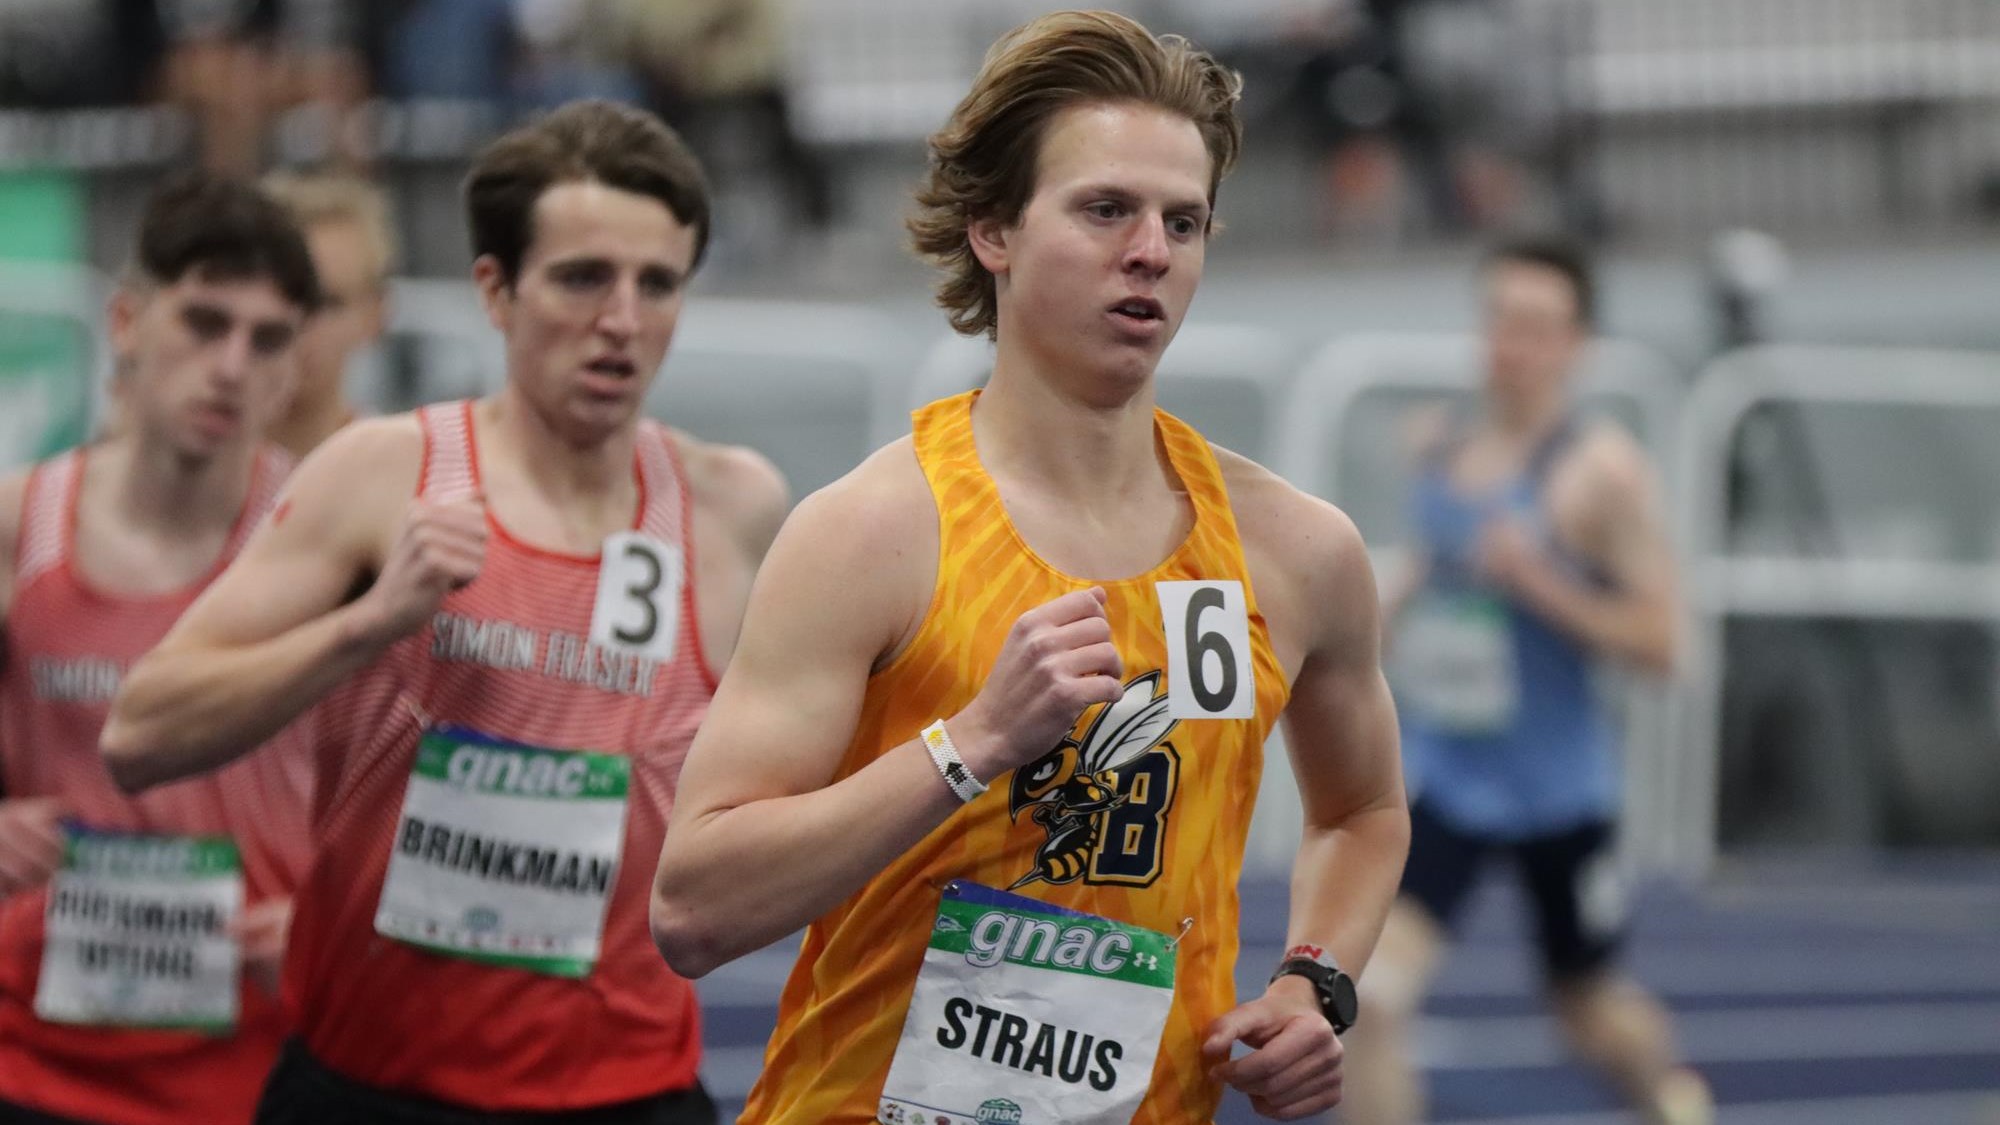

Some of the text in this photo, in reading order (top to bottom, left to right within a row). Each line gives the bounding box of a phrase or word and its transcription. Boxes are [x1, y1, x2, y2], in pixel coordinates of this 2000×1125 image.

[611, 544, 662, 646] 3
[431, 611, 537, 671] SIMON
[1184, 586, 1238, 713] 6
[446, 743, 590, 797] gnac
[1083, 740, 1181, 889] B
[400, 816, 612, 896] BRINKMAN
[964, 910, 1133, 974] gnac
[936, 996, 1124, 1092] STRAUS
[977, 1104, 1022, 1122] gnac
